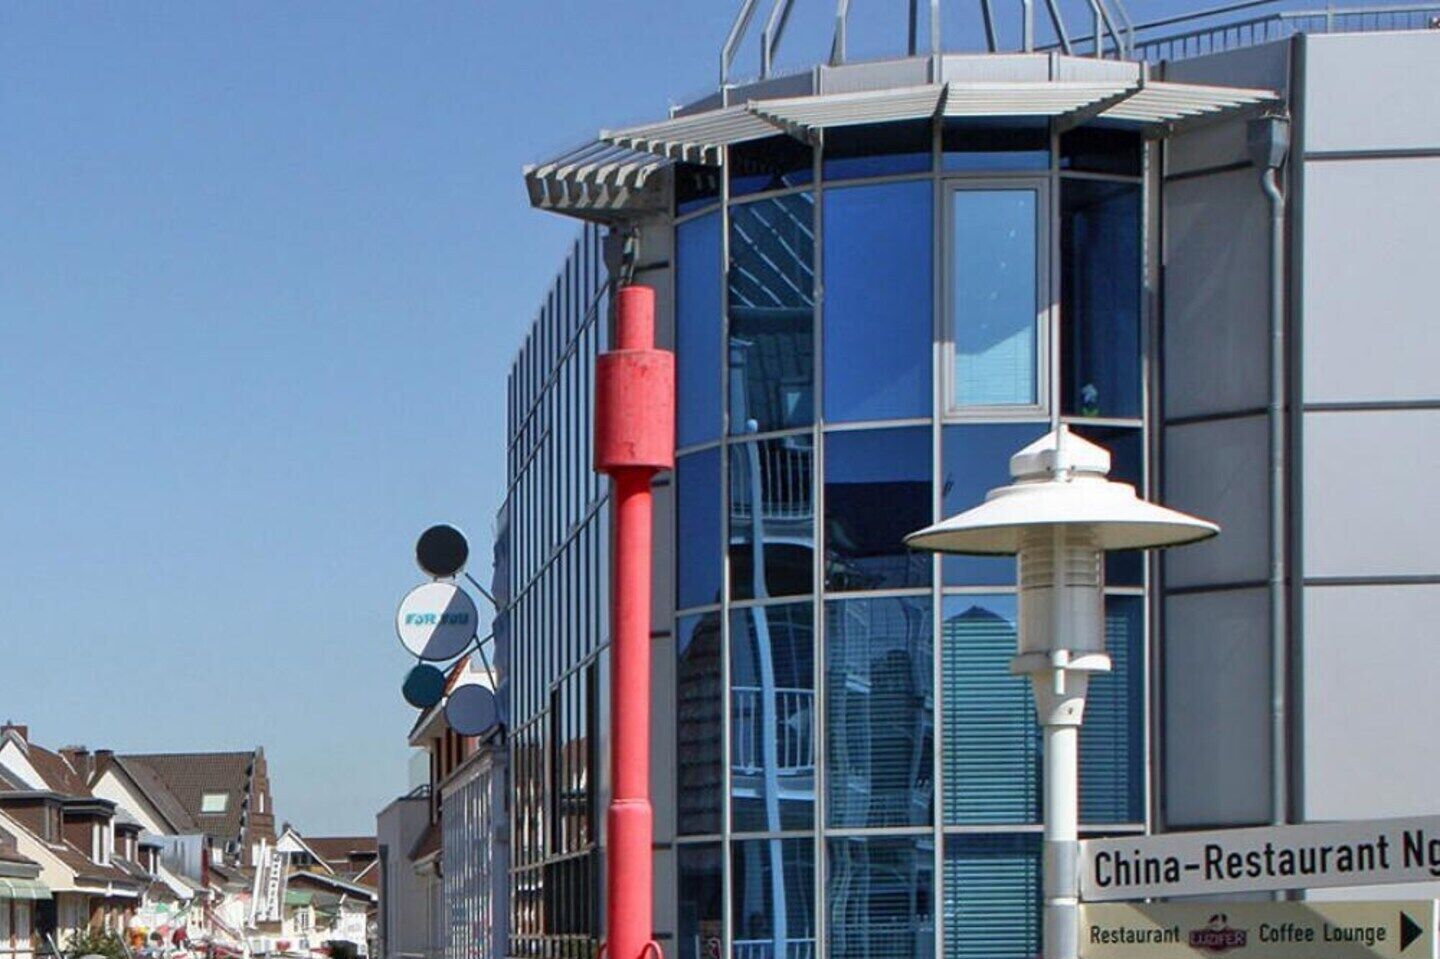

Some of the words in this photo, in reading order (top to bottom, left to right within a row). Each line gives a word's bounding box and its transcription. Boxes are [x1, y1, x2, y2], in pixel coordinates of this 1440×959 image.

[1094, 835, 1390, 888] China-Restaurant
[1090, 925, 1180, 945] Restaurant
[1259, 923, 1315, 944] Coffee
[1323, 924, 1387, 947] Lounge
